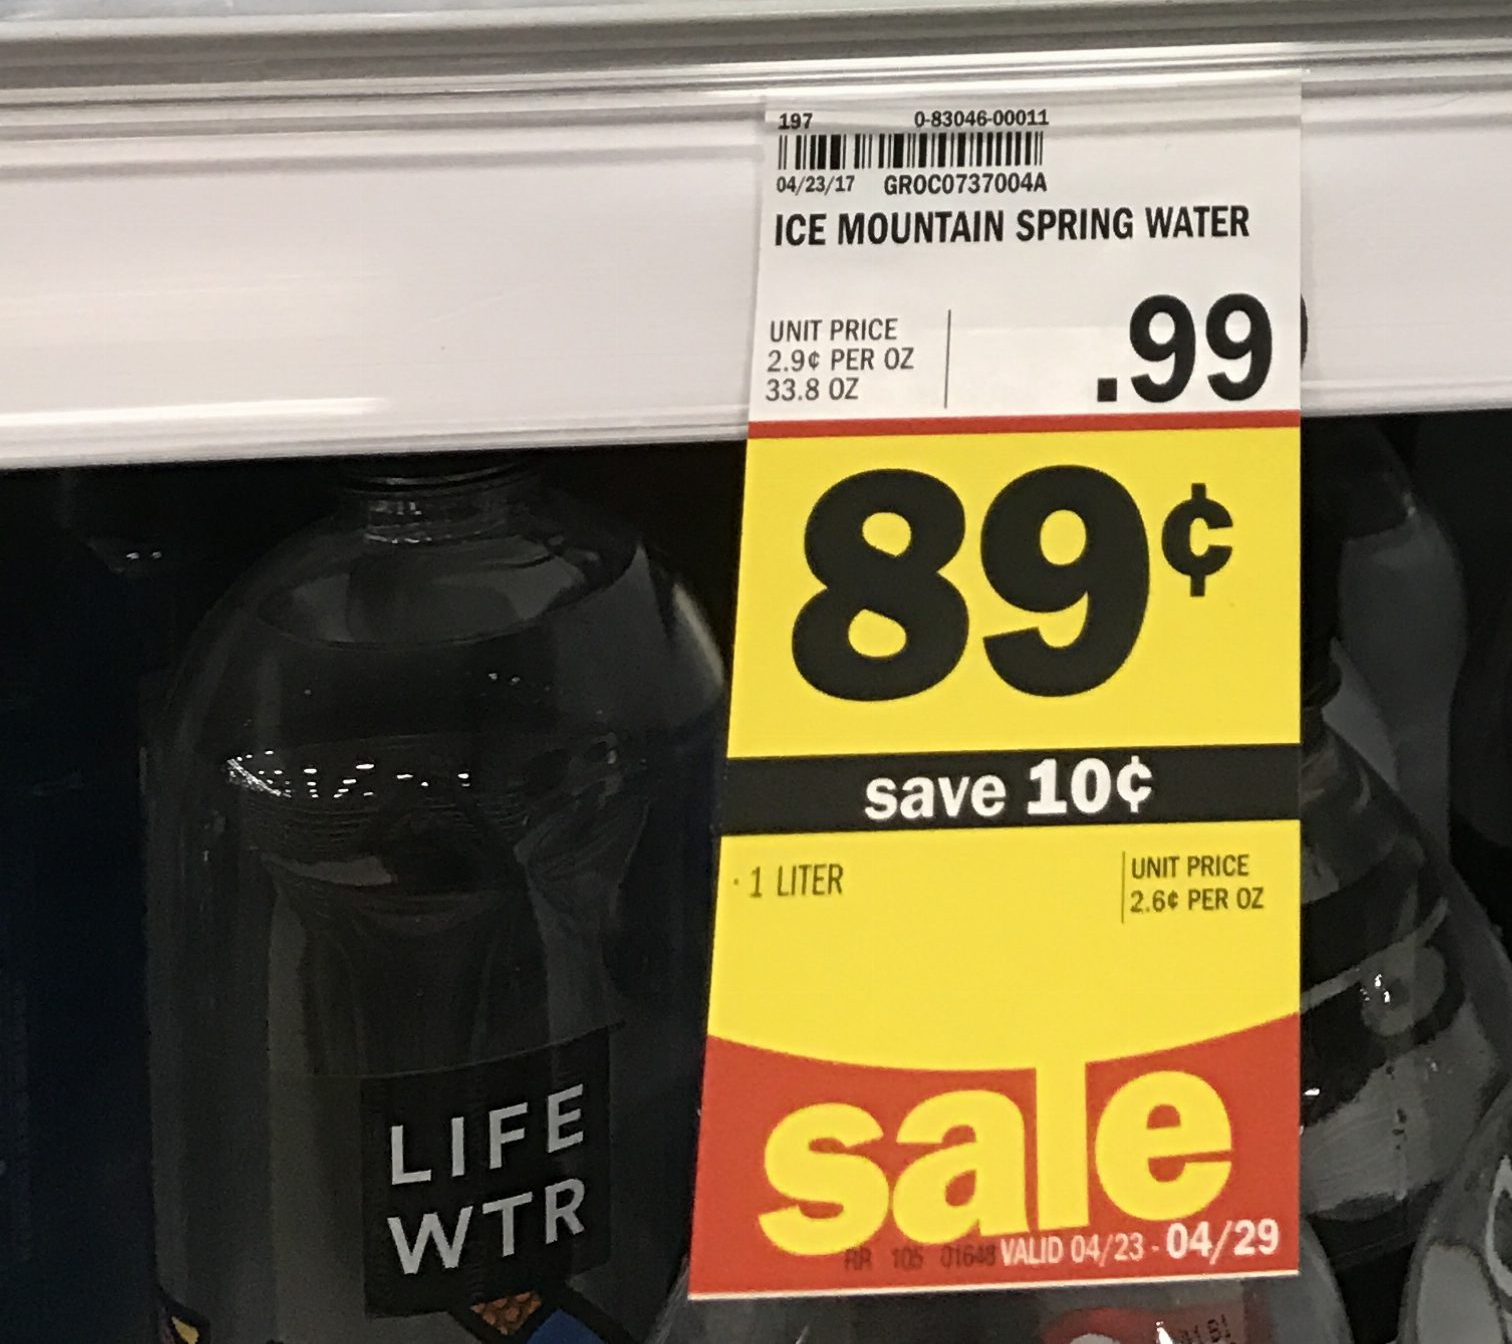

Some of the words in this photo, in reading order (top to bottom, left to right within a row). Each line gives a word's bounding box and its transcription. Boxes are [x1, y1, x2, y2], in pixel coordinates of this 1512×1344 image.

[778, 113, 813, 131] 197
[914, 109, 1049, 129] 0-83046-00011
[776, 175, 856, 197] 04/23/17
[884, 174, 1047, 196] GROC0737004A
[775, 213, 827, 246] ICE
[837, 209, 1004, 245] MOUNTAIN
[1016, 206, 1134, 241] SPRING
[1145, 205, 1251, 239] WATER
[770, 319, 823, 343] UNIT
[830, 318, 898, 342] PRICE
[1097, 292, 1273, 403] .99
[767, 348, 821, 374] 2.9¢
[831, 347, 875, 372] PER
[884, 346, 915, 371] OZ
[765, 378, 820, 403] 33.8
[829, 377, 860, 401] OZ
[864, 769, 1008, 822] save
[1027, 755, 1154, 816] 10¢
[776, 863, 844, 897] LITER
[1132, 856, 1181, 881] UNIT
[1187, 854, 1250, 878] PRICE
[1130, 888, 1180, 915] 2.6¢
[1188, 887, 1230, 912] PER
[1237, 885, 1265, 910] OZ
[392, 1082, 586, 1188] LIFE
[758, 1065, 1232, 1256] sale
[387, 1176, 586, 1276] WTR
[1000, 1236, 1064, 1267] VALID
[1071, 1232, 1144, 1267] 04/23
[1166, 1218, 1280, 1265] 04/29
